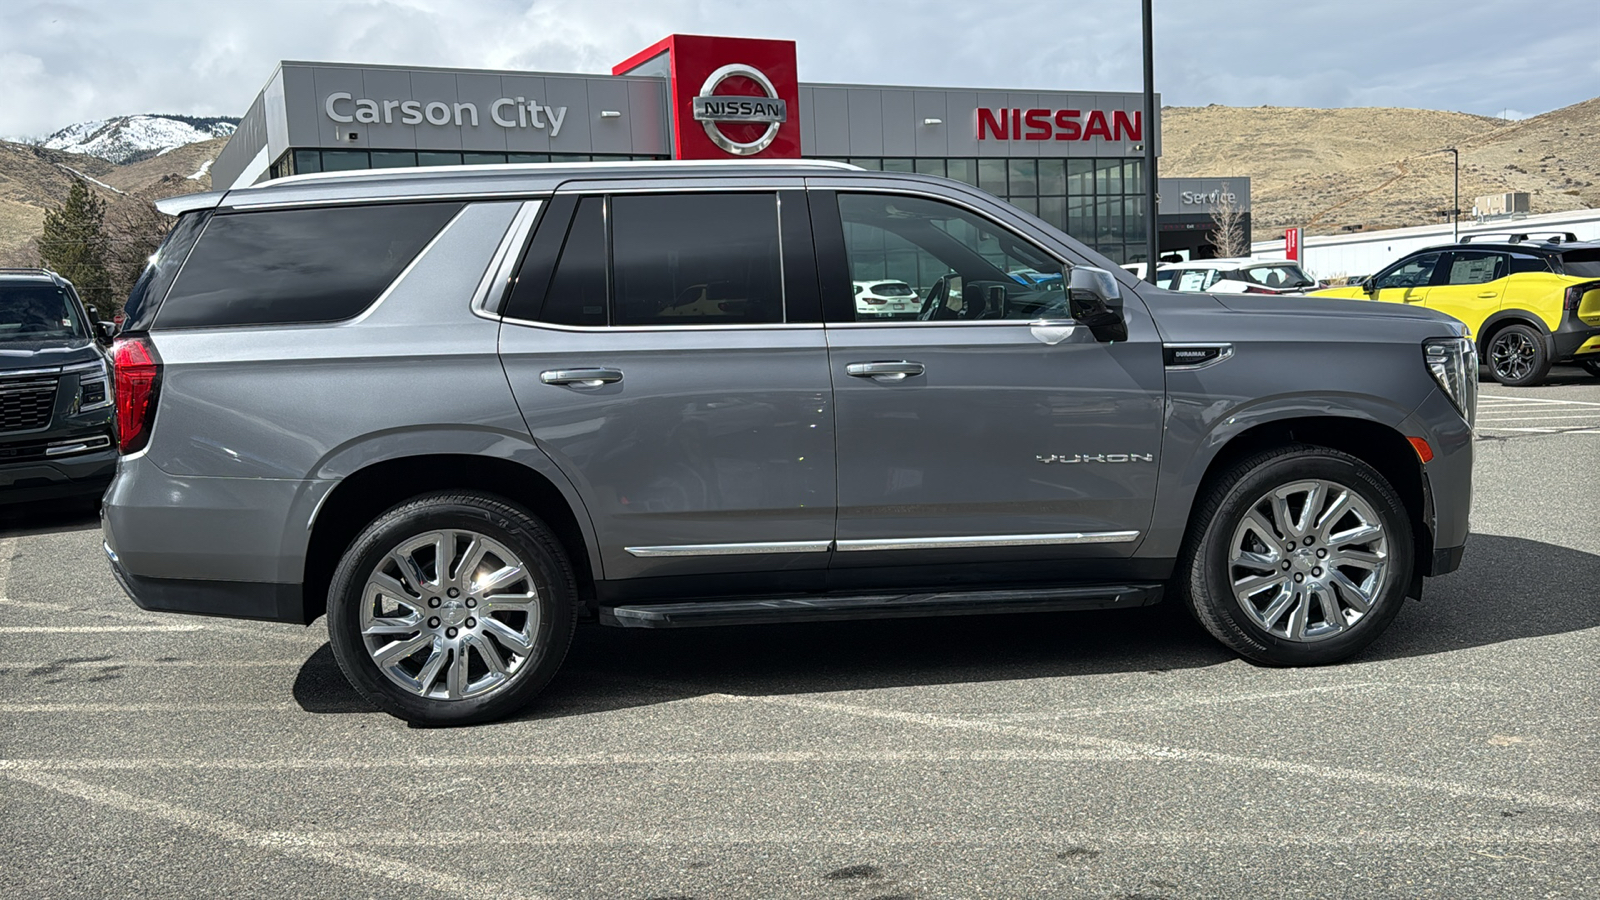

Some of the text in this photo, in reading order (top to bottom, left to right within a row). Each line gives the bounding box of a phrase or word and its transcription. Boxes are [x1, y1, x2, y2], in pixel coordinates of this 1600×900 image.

[325, 91, 568, 138] Carson City
[704, 101, 780, 118] NISSAN
[976, 107, 1143, 142] NISSAN
[1183, 189, 1237, 205] Service
[1036, 453, 1153, 464] YUKON
